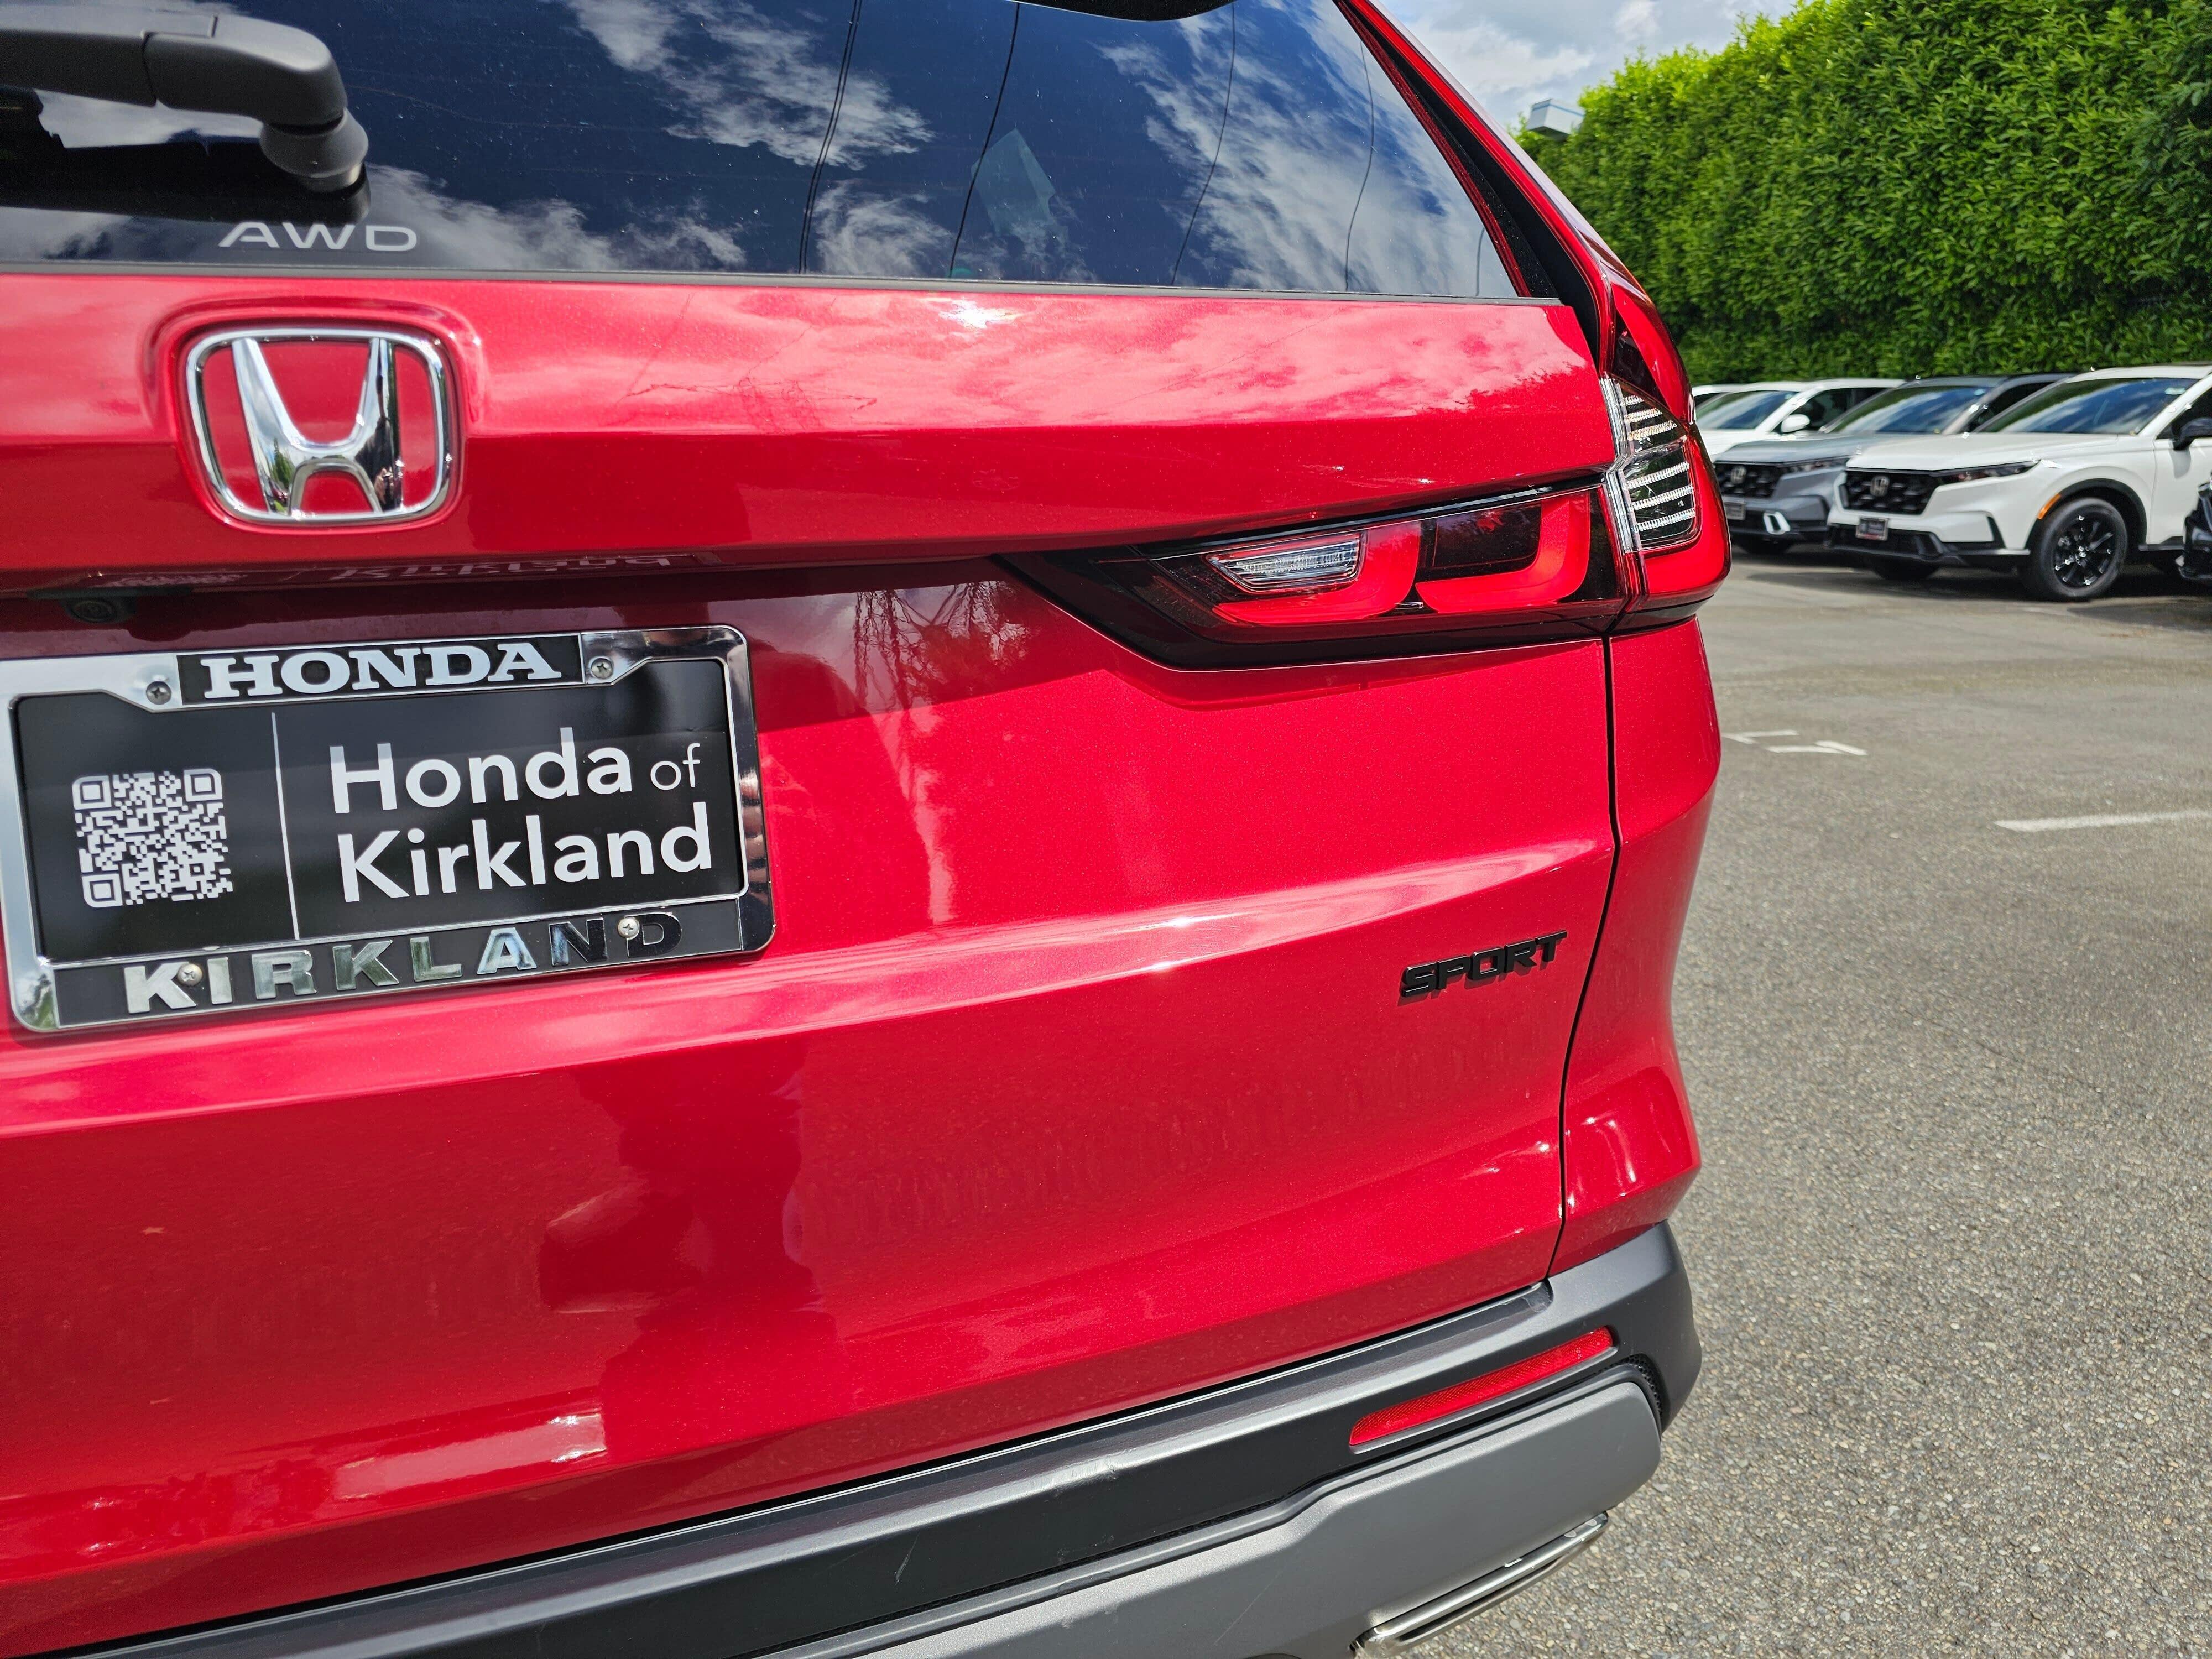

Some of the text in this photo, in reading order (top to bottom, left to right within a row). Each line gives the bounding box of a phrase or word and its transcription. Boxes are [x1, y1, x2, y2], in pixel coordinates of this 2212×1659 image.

[220, 221, 418, 252] AWD
[200, 642, 562, 699] HONDA
[330, 727, 701, 814] Honda of
[337, 801, 712, 902] Kirkland
[124, 912, 683, 1014] KIRKLAND
[1400, 929, 1567, 998] SPORT
